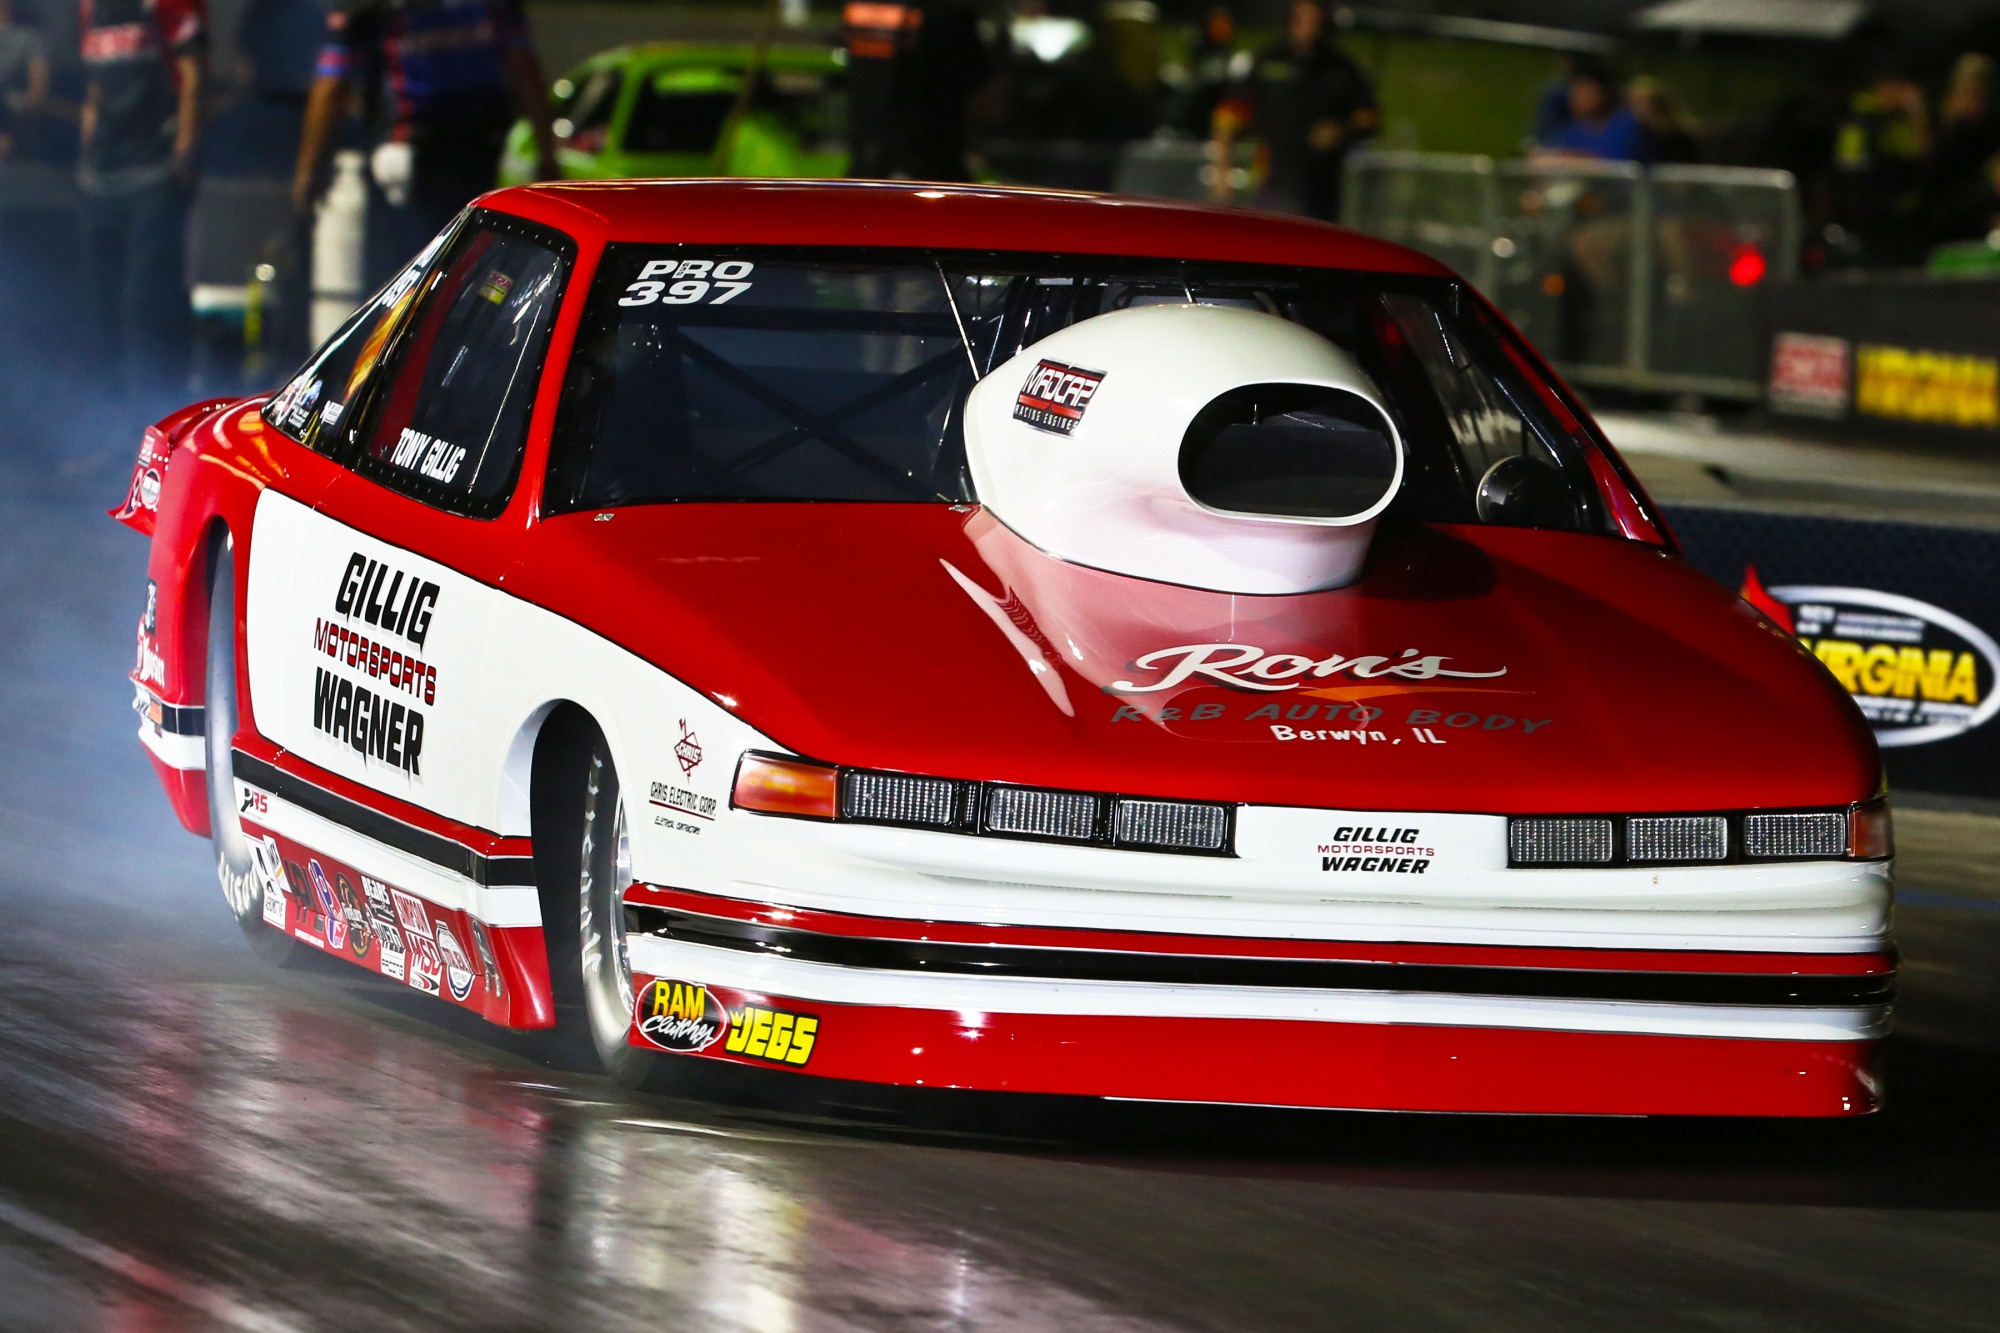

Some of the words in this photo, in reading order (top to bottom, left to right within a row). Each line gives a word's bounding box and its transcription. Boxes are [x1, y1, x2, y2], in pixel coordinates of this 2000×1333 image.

[637, 260, 755, 280] PRO
[618, 280, 753, 307] 397
[1014, 404, 1042, 421] RACING
[1043, 413, 1079, 431] ENGINES
[390, 427, 432, 470] TONY
[420, 438, 466, 484] GILLIG
[335, 551, 441, 653] GILLIG
[313, 617, 437, 707] MOTORSPORTS
[1112, 643, 1507, 692] Ron's
[1798, 637, 1978, 705] RGINIA
[313, 666, 425, 786] WAGNER
[1110, 703, 1226, 722] R&B
[1244, 703, 1384, 722] AUTO
[1405, 708, 1553, 734] BODY
[1269, 724, 1401, 745] Berwyn,
[1411, 727, 1447, 744] IL
[650, 781, 668, 801] CHRIS
[669, 786, 698, 810] ELECTRIC
[1317, 845, 1435, 856] MOTORSPORTS
[1333, 827, 1420, 844] GILLIG
[1322, 857, 1430, 874] WAGNER
[653, 981, 705, 1020] RAM
[726, 1007, 818, 1064] JEGS
